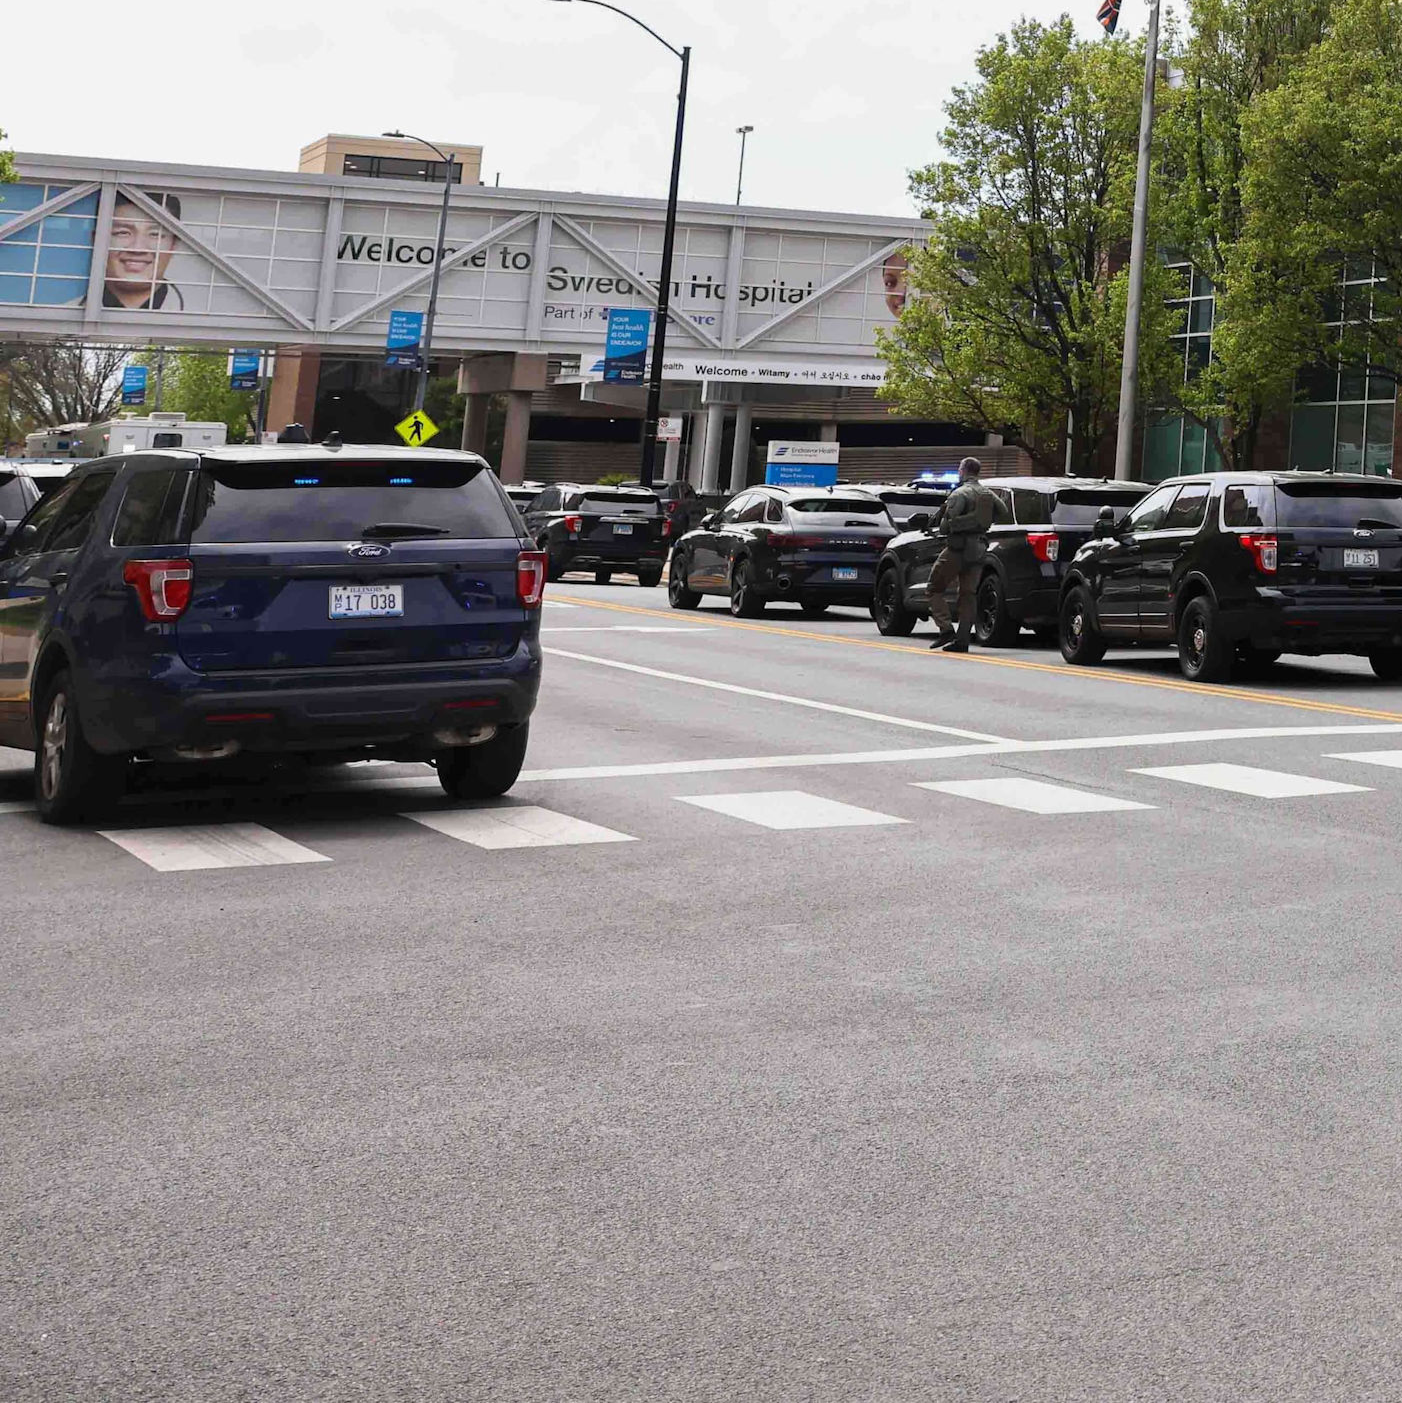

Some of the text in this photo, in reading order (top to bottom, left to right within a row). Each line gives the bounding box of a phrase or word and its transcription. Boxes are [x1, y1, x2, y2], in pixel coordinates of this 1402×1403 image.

[500, 246, 532, 270] to
[690, 274, 813, 307] Hospital
[544, 305, 594, 320] Part of
[663, 362, 684, 370] ealth
[695, 365, 790, 378] Welcome Witamy
[358, 547, 382, 556] Ford
[345, 594, 362, 611] 17
[370, 594, 396, 610] 038
